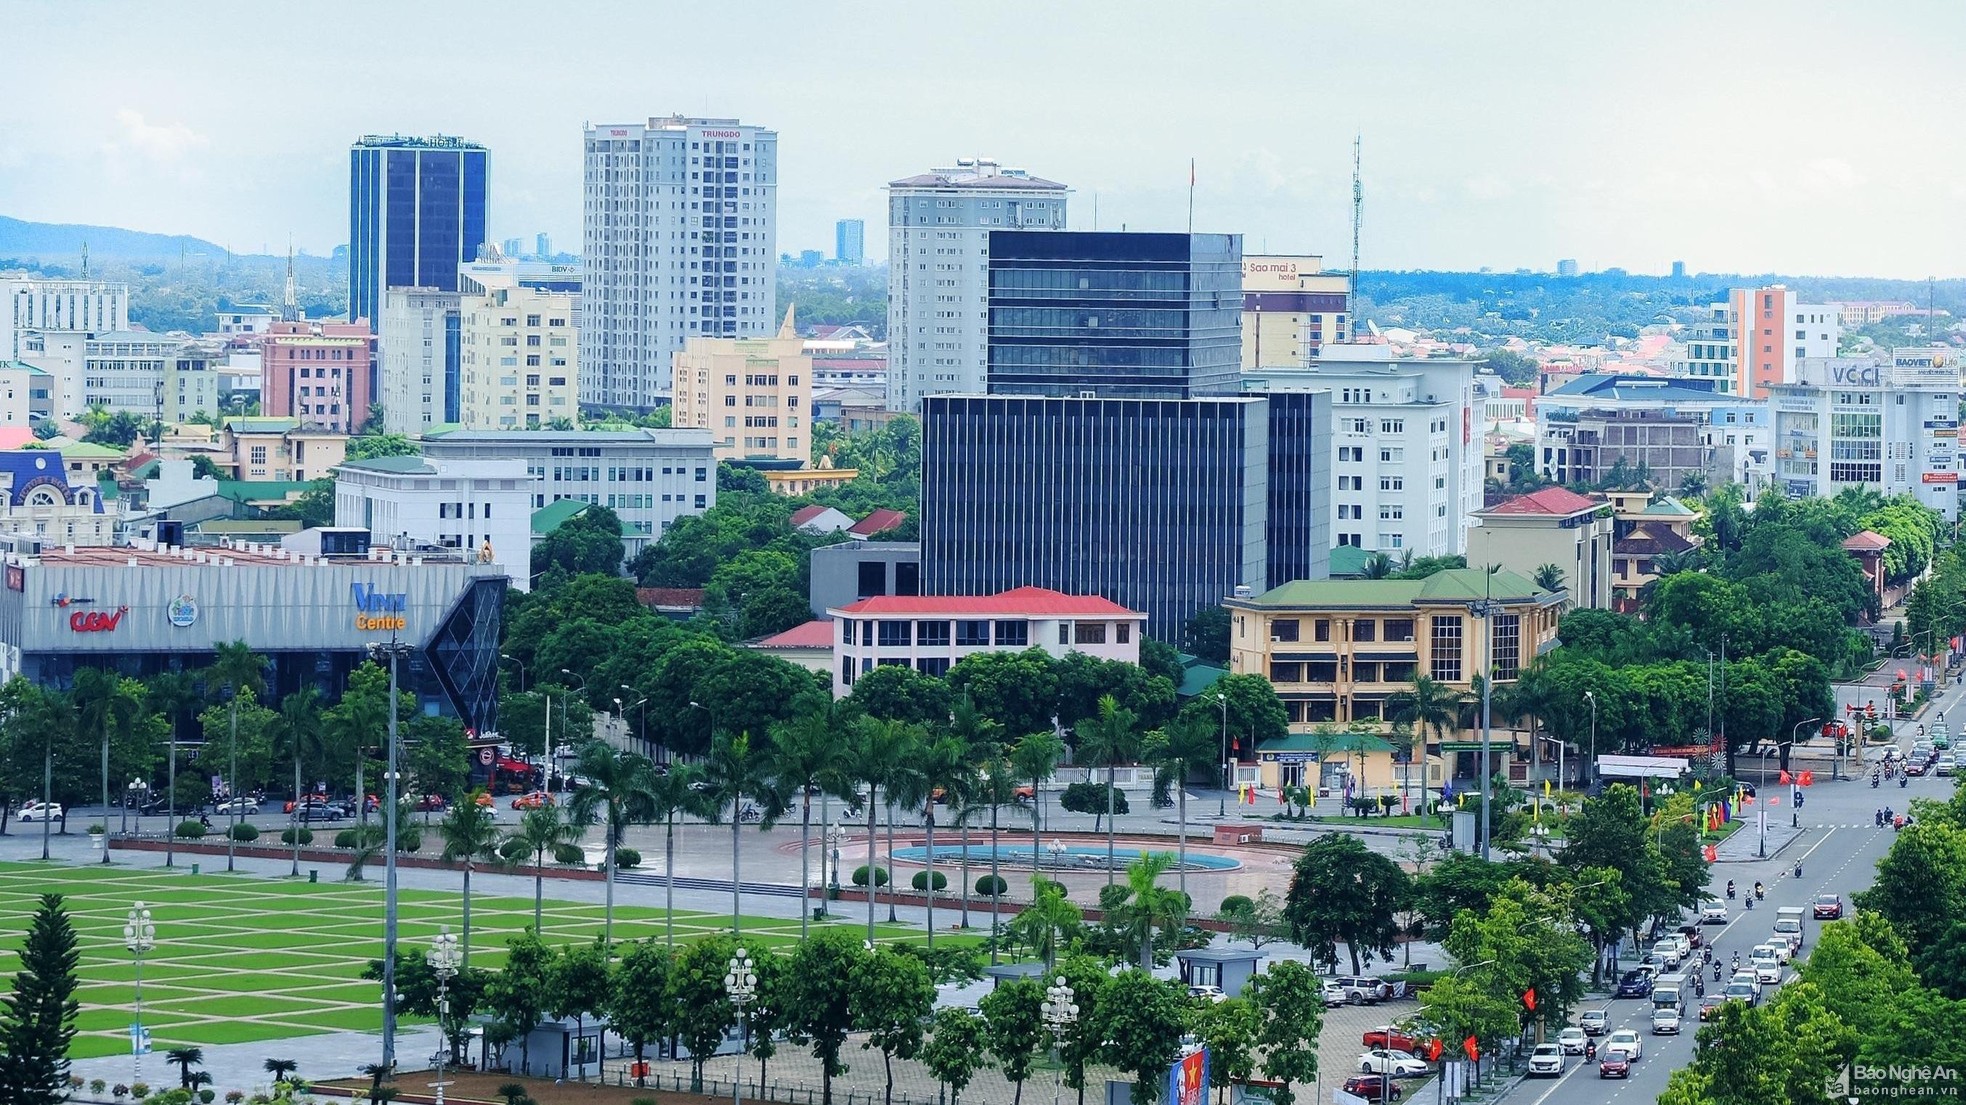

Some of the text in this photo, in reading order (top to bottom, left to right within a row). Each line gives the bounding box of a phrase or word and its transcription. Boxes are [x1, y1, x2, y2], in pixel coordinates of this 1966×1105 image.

[701, 130, 741, 138] TRUNGDO
[1250, 262, 1268, 273] Sao
[1270, 262, 1289, 273] mai
[1290, 263, 1297, 273] 3
[1278, 273, 1296, 281] hotel
[1895, 358, 1932, 368] BAOVIET
[1833, 366, 1880, 384] VCCI
[70, 611, 121, 632] CGV
[356, 614, 406, 631] Centre
